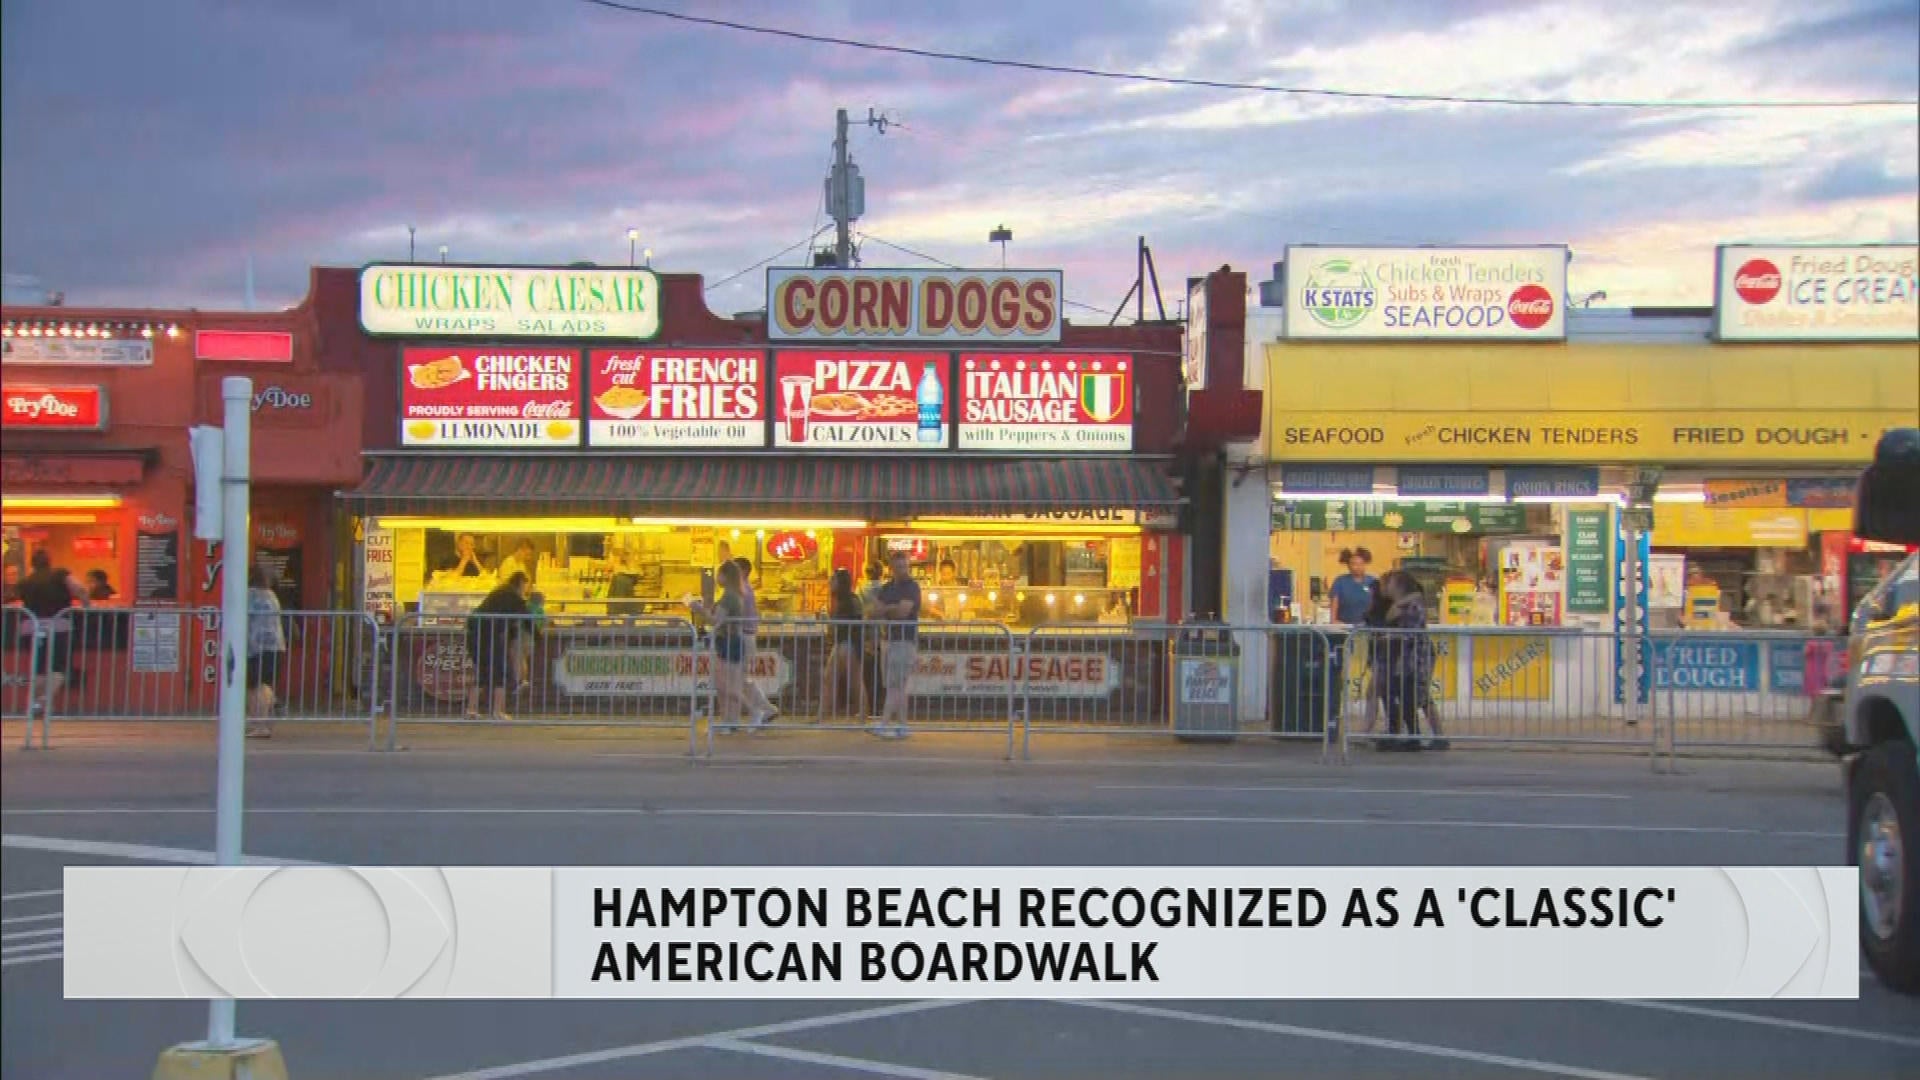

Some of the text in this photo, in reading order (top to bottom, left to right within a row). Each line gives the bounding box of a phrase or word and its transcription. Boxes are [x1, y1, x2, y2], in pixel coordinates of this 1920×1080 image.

[1376, 264, 1545, 283] Chicken Tenders
[1790, 256, 1918, 277] Fried Doug
[374, 272, 646, 313] CHICKEN CAESAR
[1305, 289, 1374, 307] K STATS
[1387, 285, 1503, 305] Subs & Wraps
[1788, 279, 1826, 305] ICE
[777, 277, 1055, 334] CORN DOGS
[415, 317, 606, 333] WRAPS SALADS
[1383, 305, 1505, 328] SEAFOOD
[475, 355, 572, 373] CHICKEN
[601, 354, 645, 374] fresh
[651, 357, 758, 383] FRENCH
[477, 373, 569, 391] FINGERS
[611, 371, 636, 385] cut
[815, 359, 913, 391] PIZZA
[965, 371, 1078, 399] ITALIAN
[408, 406, 464, 417] PROUDLY
[466, 406, 519, 417] SERVING
[650, 384, 759, 419] FRIES
[965, 399, 1078, 423] SAUSAGE
[440, 421, 542, 440] LEMONADE
[608, 424, 746, 439] 100% Vegetable Oil
[812, 425, 912, 442] CALZONES
[965, 427, 1126, 444] with Peppers & Onions
[1284, 427, 1385, 445] SEAFOOD
[1437, 427, 1531, 445] CHICKEN
[1541, 427, 1639, 445] TENDERS
[1673, 427, 1745, 445] FRIED
[1756, 427, 1849, 445] DOUGH
[966, 656, 1104, 682] SAUSAGE
